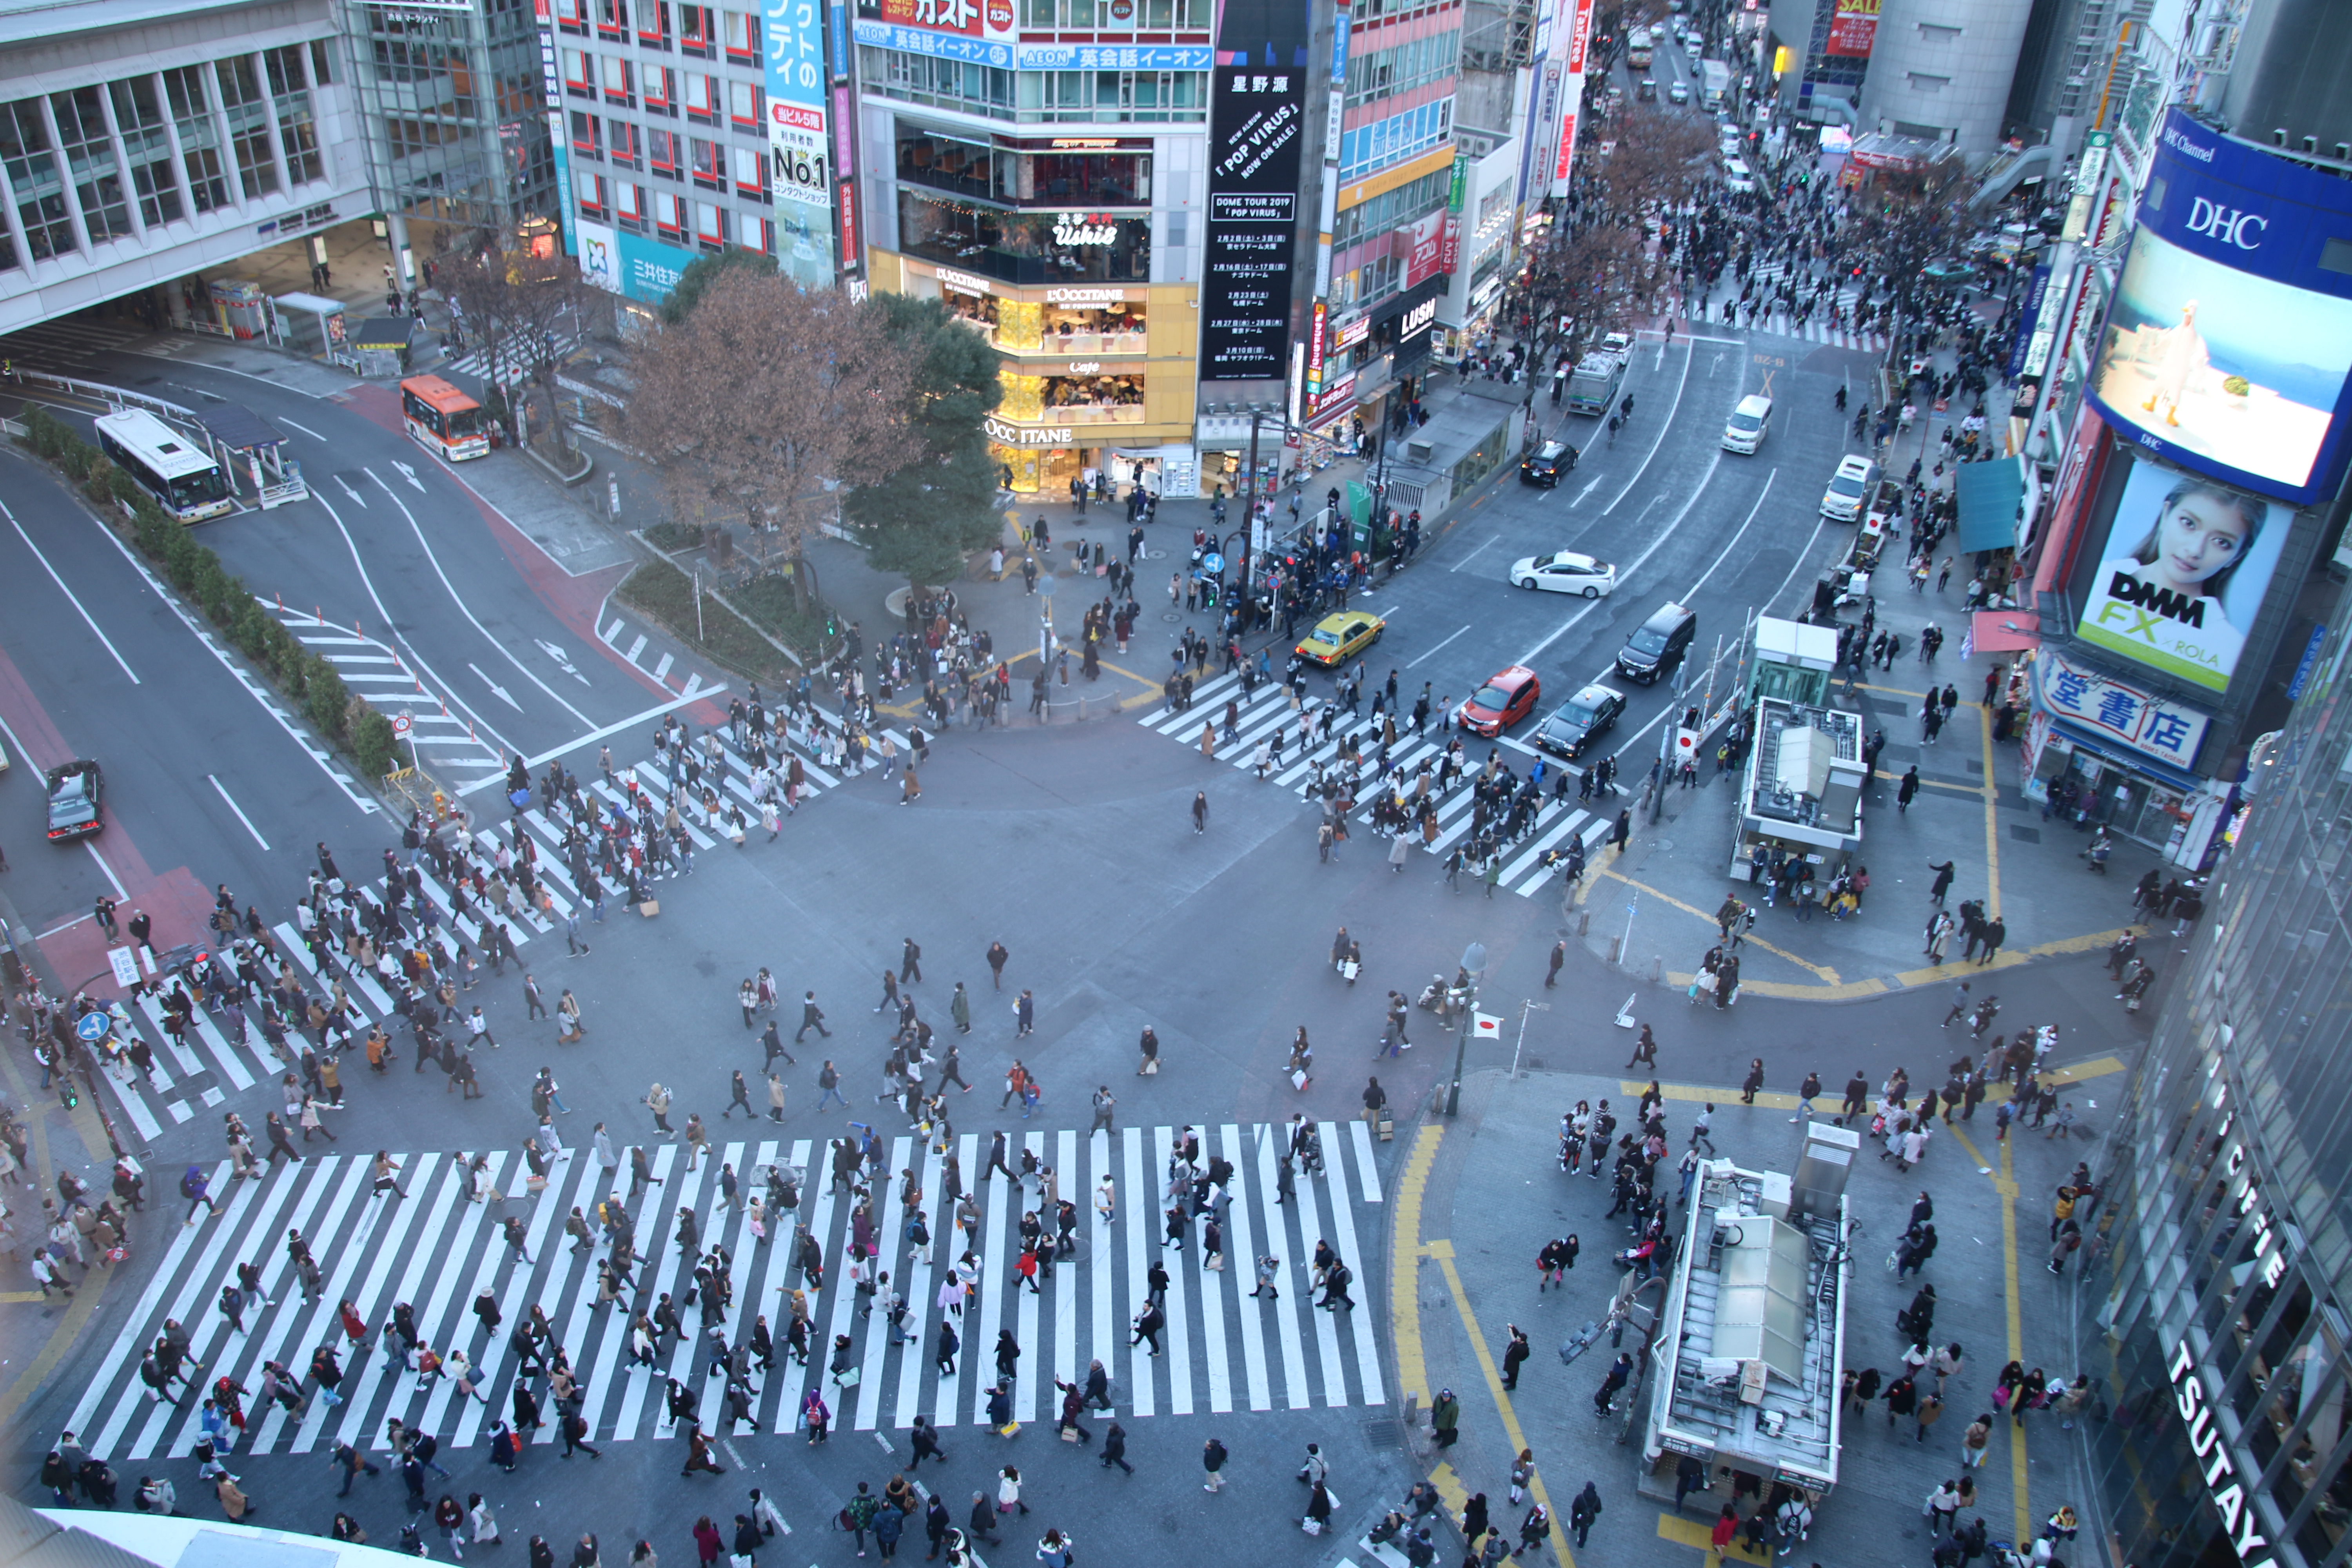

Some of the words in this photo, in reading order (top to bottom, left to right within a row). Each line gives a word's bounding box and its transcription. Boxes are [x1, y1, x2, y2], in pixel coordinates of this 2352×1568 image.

[858, 25, 887, 42] AEON
[895, 29, 985, 60] 英会話イーオン
[539, 32, 558, 94] 加藤眼科
[1024, 50, 1069, 67] AEON
[1080, 48, 1209, 67] 英会話イーオン
[1231, 75, 1289, 93] 星野源
[777, 106, 820, 130] 当ビル5階
[1228, 129, 1243, 145] NEW
[1241, 111, 1263, 133] ALBUM
[781, 130, 814, 147] 利用者数
[2163, 126, 2179, 147] DHC
[2177, 136, 2214, 163] Channel
[772, 143, 827, 192] No.1
[1240, 157, 1262, 180] NOW
[1260, 146, 1275, 161] ON
[774, 183, 828, 205] コンタクトショップ
[843, 185, 853, 227] 外貨両替
[1216, 198, 1242, 207] DOME
[1244, 198, 1268, 207] TOUR
[1269, 198, 1290, 207] 2019
[1052, 224, 1118, 246] Ushi8
[2184, 196, 2269, 250] DHC
[1414, 239, 1437, 266] アコム
[633, 258, 682, 287] 三井住友
[936, 268, 991, 292] L'OCCITANE
[1046, 288, 1123, 302] L'OCCITANE
[1401, 297, 1436, 336] LUSH
[2140, 433, 2162, 451] DHC
[2107, 570, 2206, 629] DMM
[2097, 601, 2165, 644] FX
[2175, 640, 2219, 667] ROLA
[2139, 742, 2158, 755] BOOKS
[2160, 749, 2186, 766] TAISEIDO
[1662, 1441, 1690, 1453] 渋谷駅
[2170, 1339, 2279, 1568] TSUTAY
